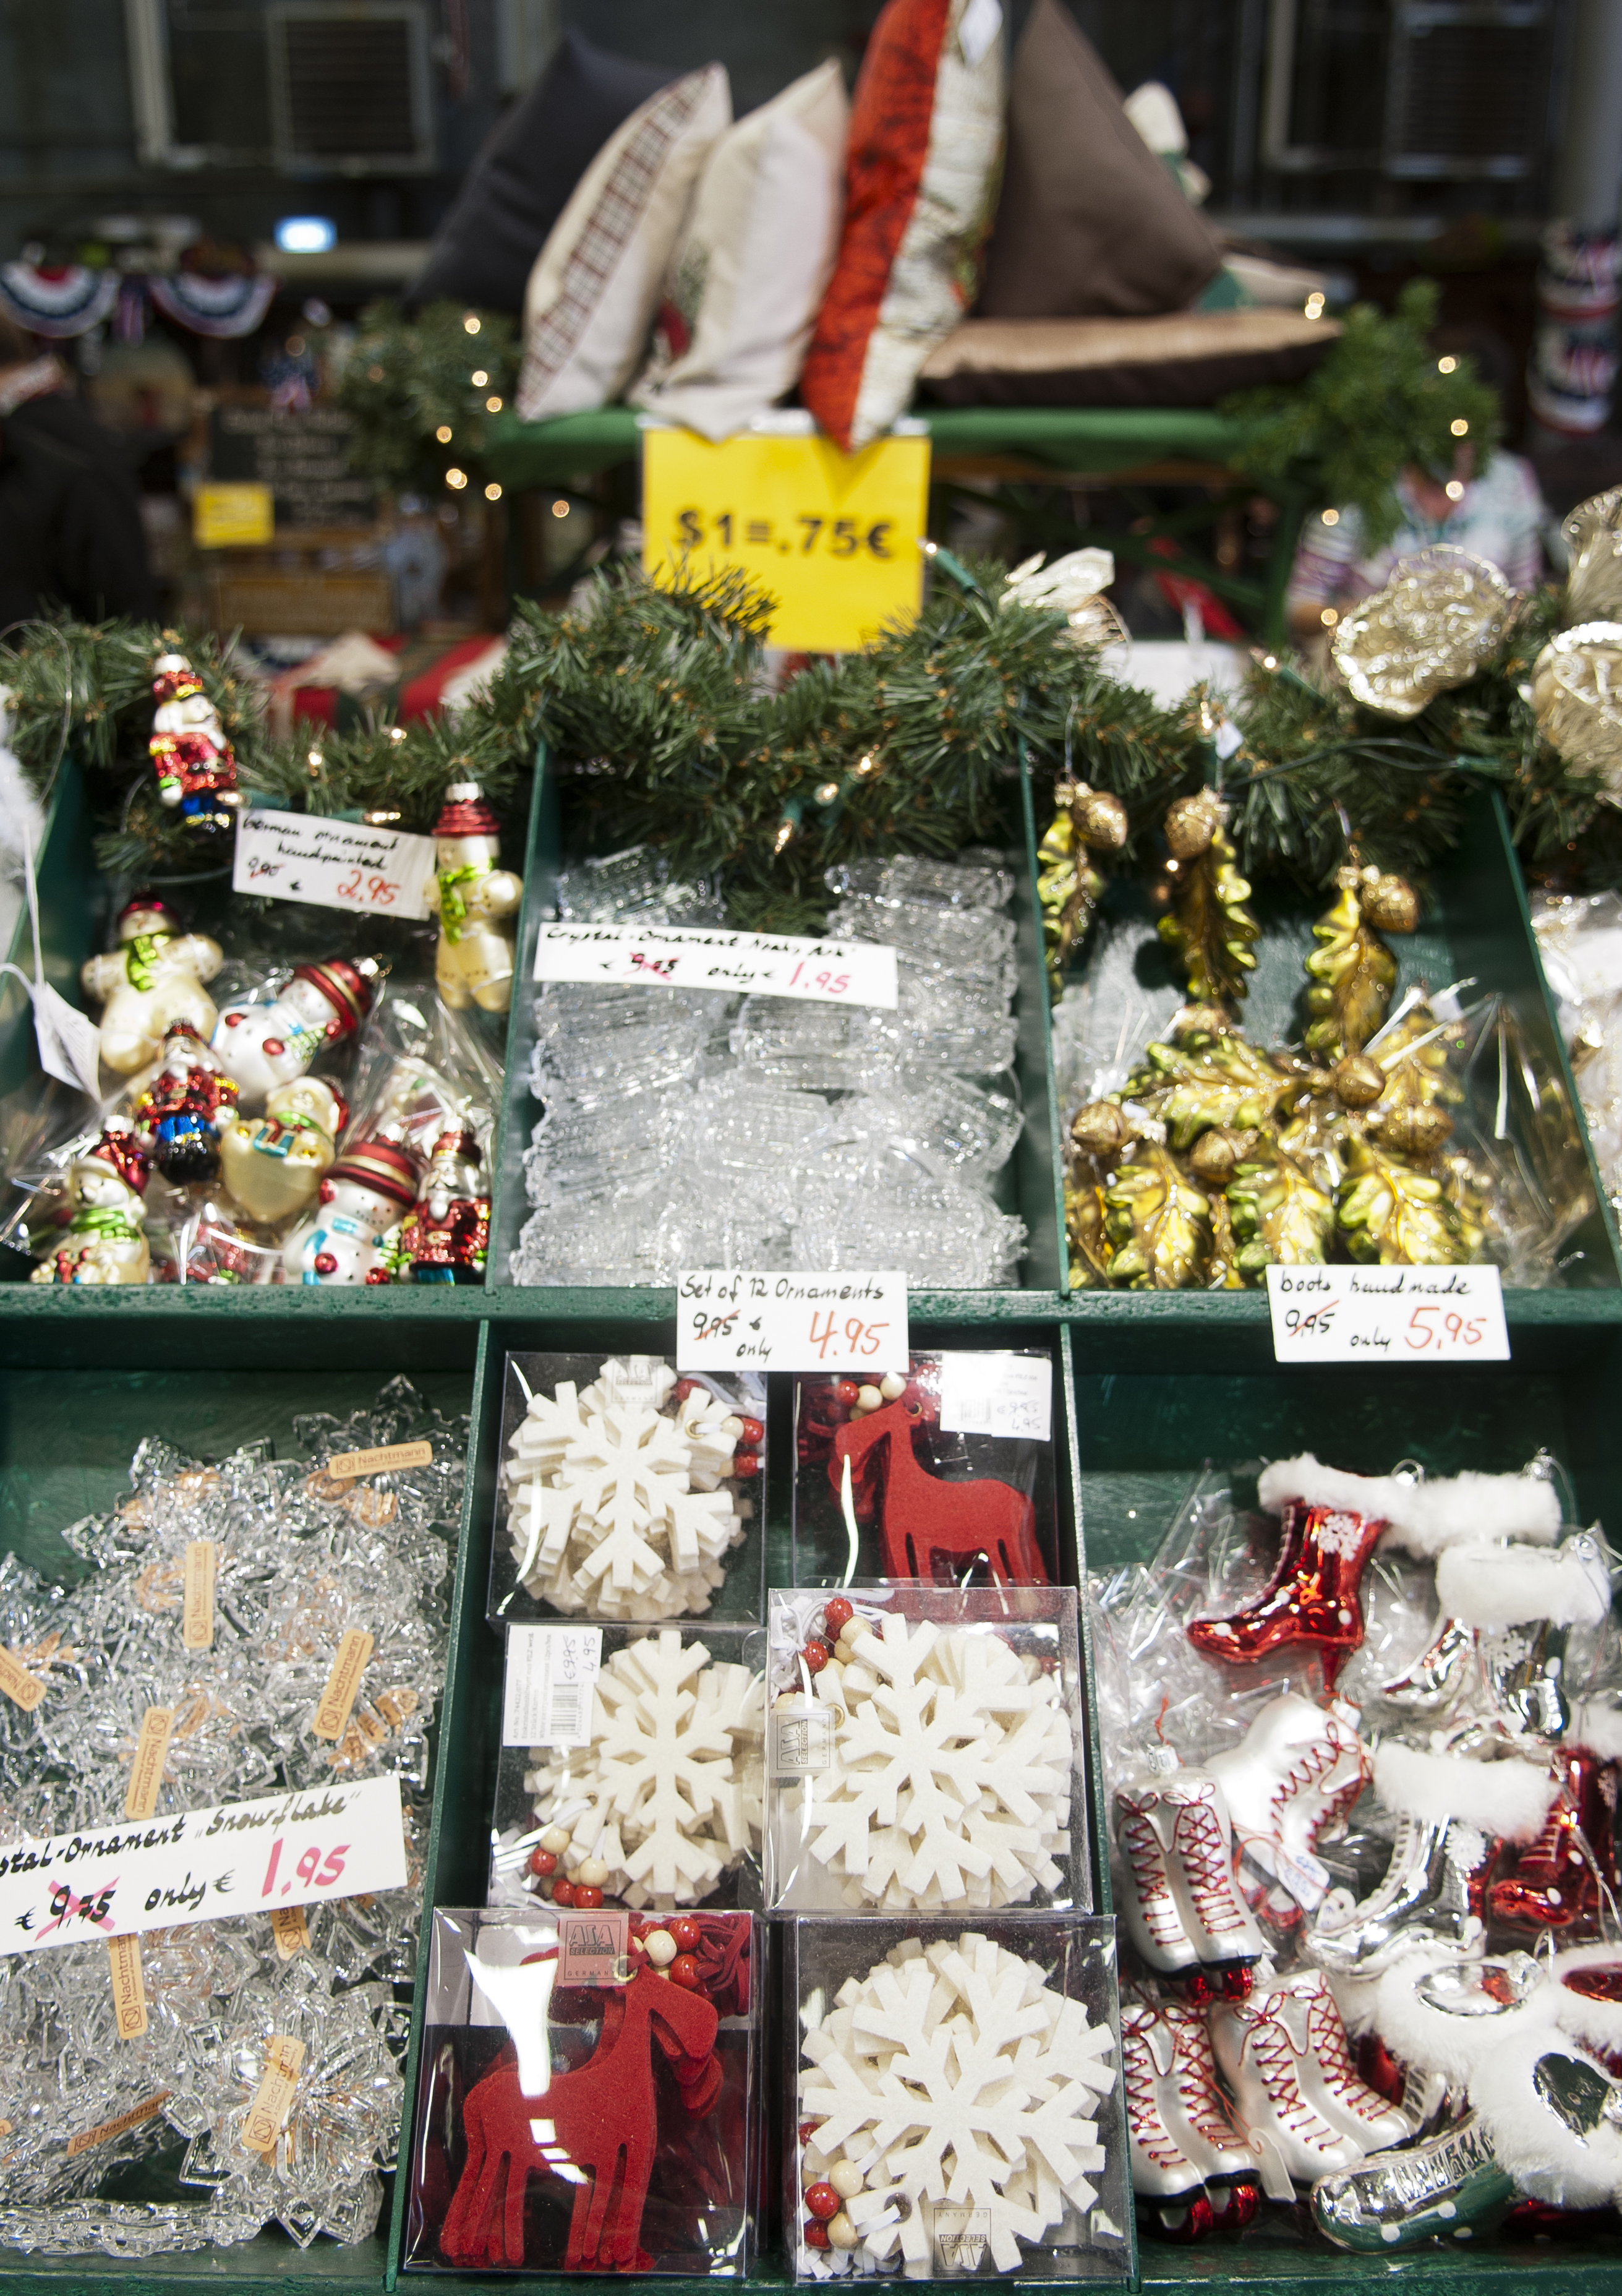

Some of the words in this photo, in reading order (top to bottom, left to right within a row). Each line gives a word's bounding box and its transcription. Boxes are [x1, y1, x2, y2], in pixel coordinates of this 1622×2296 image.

[680, 1274, 712, 1298] Set
[718, 1274, 742, 1303] of
[749, 1277, 769, 1298] 12
[775, 1276, 884, 1300] Ornaments
[1281, 1270, 1331, 1293] boots
[736, 1335, 772, 1363] only
[1351, 1326, 1391, 1352] only
[358, 1447, 425, 1464] Nachtmann
[328, 1635, 361, 1707] Nachtmann
[137, 1738, 162, 1813] Nachtmann
[145, 1871, 206, 1912] only
[117, 1934, 132, 2005] Nachtman
